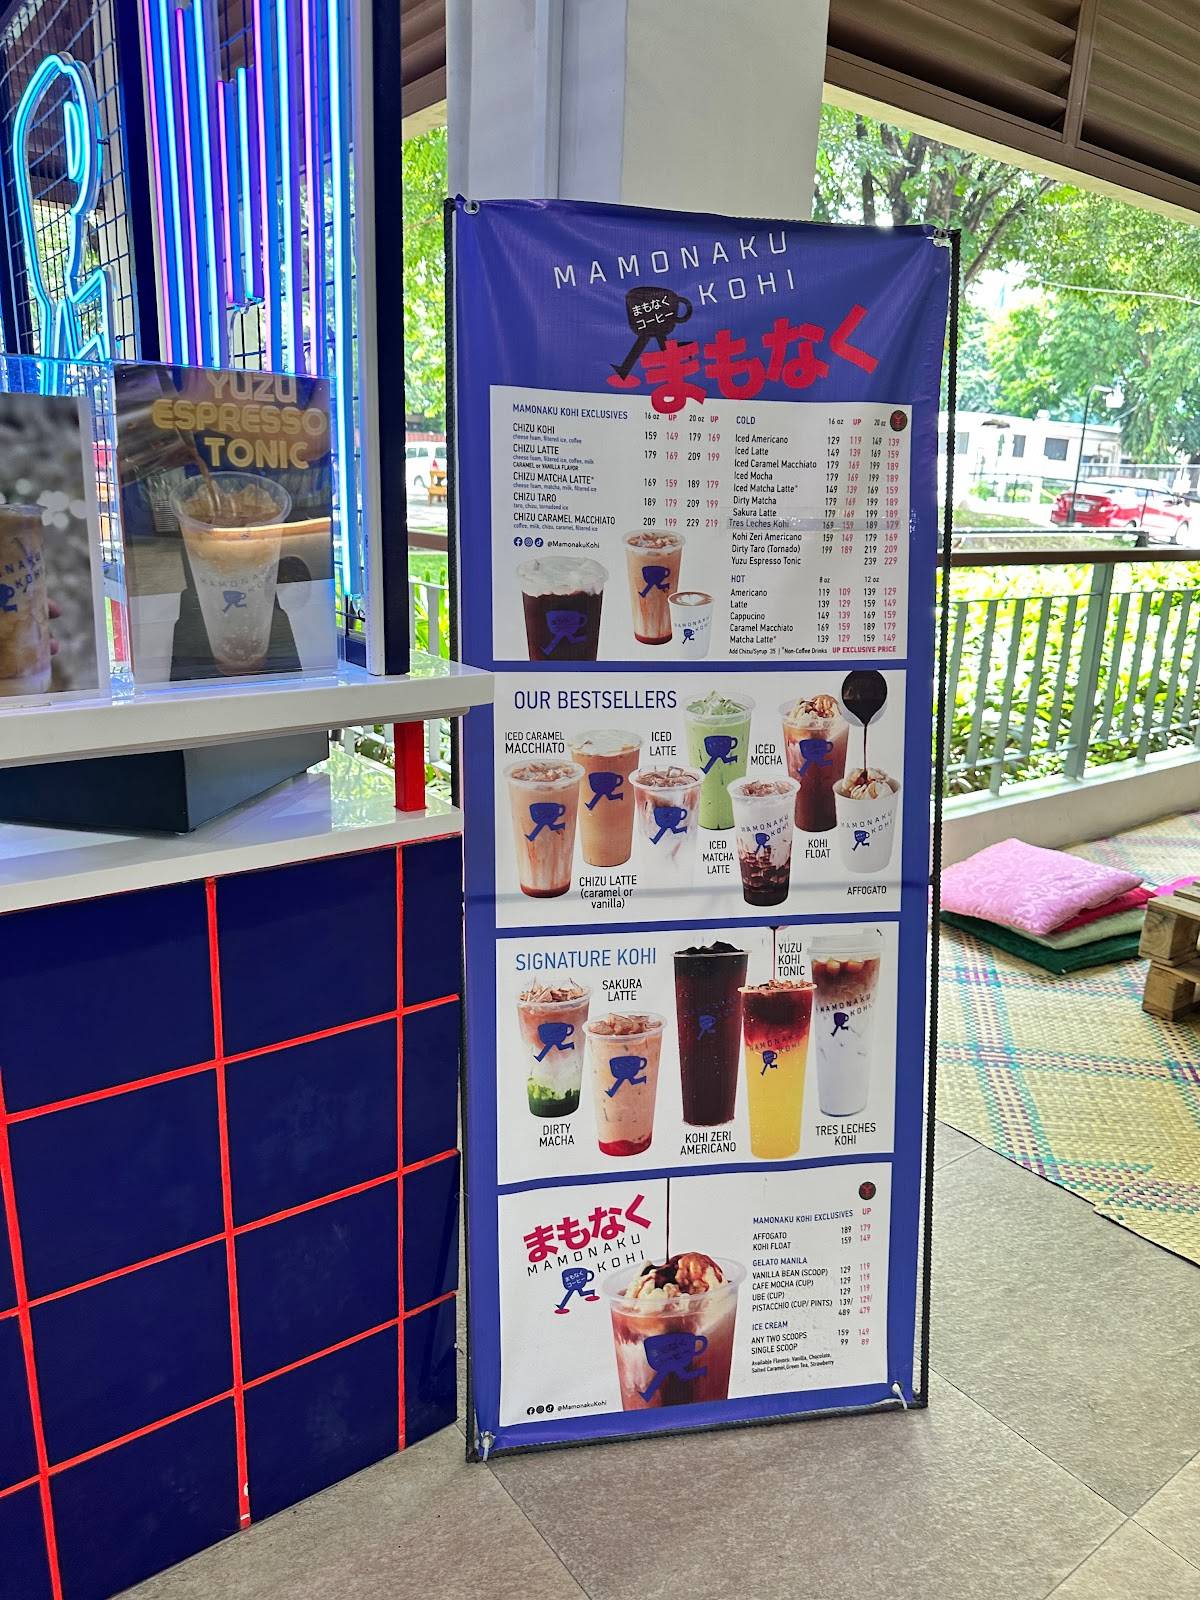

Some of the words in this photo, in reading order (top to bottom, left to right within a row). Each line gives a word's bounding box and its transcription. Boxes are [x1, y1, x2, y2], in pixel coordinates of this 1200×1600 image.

[554, 230, 788, 289] MAMONAKU
[699, 269, 794, 306] KOHI
[632, 296, 670, 316] まもなく
[635, 312, 674, 330] コーヒー
[639, 303, 878, 415] まもなく
[205, 371, 297, 403] YUZU
[513, 404, 558, 416] MAMONAKU
[560, 408, 579, 417] KOHI
[581, 409, 628, 419] EXCLUSIVES
[151, 400, 327, 435] ESPRESSO
[736, 416, 755, 424] COLD
[513, 423, 535, 433] CHIZU
[537, 425, 554, 434] KOHI
[644, 432, 657, 440] 159
[689, 433, 701, 441] 179
[708, 434, 720, 442] 169
[735, 434, 750, 443] Iced
[752, 435, 788, 444] Americano
[828, 437, 840, 445] 129
[205, 438, 309, 469] TONIC
[513, 444, 535, 453] CHIZU
[537, 445, 559, 455] LATTE
[644, 451, 656, 459] 179
[688, 452, 700, 460] 209
[735, 447, 749, 455] Iced
[827, 449, 839, 457] 149
[750, 460, 779, 468] Caramel
[781, 460, 816, 468] Macchiato
[827, 461, 839, 469] 179
[513, 472, 535, 481] CHIZU
[538, 473, 567, 483] MATCHA
[644, 479, 656, 487] 169
[688, 480, 700, 488] 189
[750, 472, 772, 480] Mocha
[826, 473, 838, 481] 179
[734, 484, 747, 492] Iced
[750, 485, 774, 493] Matcha
[513, 492, 535, 502] CHIZU
[538, 493, 556, 502] TARO
[644, 498, 656, 506] 189
[687, 500, 700, 508] 209
[734, 496, 749, 506] Dirty
[733, 509, 757, 517] Sakura
[759, 509, 776, 517] Latte
[514, 513, 535, 522] CHIZU
[538, 514, 572, 524] CARAMEL
[575, 516, 615, 525] MACCHIATO
[643, 517, 656, 525] 209
[687, 519, 699, 527] 229
[706, 519, 718, 527] 219
[732, 533, 747, 541] Kohi
[750, 533, 763, 541] Zeri
[732, 545, 747, 554] Dirty
[767, 545, 800, 554] (Tornado)
[732, 557, 747, 565] Yuzu
[750, 557, 781, 566] Espresso
[784, 557, 801, 565] Tonic
[864, 558, 876, 566] 239
[730, 600, 747, 608] Latte
[818, 600, 829, 608] 139
[730, 612, 765, 621] Cappucino
[864, 611, 875, 619] 169
[730, 624, 758, 632] Caramel
[760, 624, 793, 632] Macchiato
[863, 634, 875, 642] 159
[514, 691, 551, 709] OUR
[558, 690, 677, 709] BESTSELLERS
[505, 732, 524, 741] ICED
[526, 732, 564, 740] CARAMEL
[651, 732, 672, 742] ICED
[505, 743, 565, 754] MACCHIATO
[650, 746, 676, 756] LATTE
[756, 744, 776, 754] ICED
[751, 756, 782, 765] MOCHA
[709, 841, 726, 850] ICED
[808, 840, 828, 848] KOHI
[702, 853, 734, 861] MATCHA
[806, 849, 831, 859] FLOAT
[707, 865, 730, 874] LATTE
[579, 877, 607, 887] CHIZU
[610, 875, 637, 886] LATTE
[580, 888, 621, 898] (caramel
[624, 888, 633, 897] or
[847, 886, 886, 895] AFFOGATO
[591, 899, 625, 909] vanilla)
[778, 943, 802, 953] YUZU
[516, 950, 611, 970] SIGNATURE
[618, 948, 656, 965] KOHI
[778, 955, 800, 964] KOHI
[778, 966, 805, 976] TONIC
[602, 979, 642, 990] SAKURA
[608, 990, 636, 1002] LATTE
[543, 1123, 571, 1136] DIRTY
[816, 1124, 838, 1136] TRES
[841, 1122, 876, 1134] LECHES
[539, 1135, 574, 1147] MACHA
[685, 1134, 708, 1143] KOHI
[711, 1131, 731, 1141] ZERI
[835, 1135, 856, 1146] KOHI
[680, 1142, 736, 1155] AMERICANO
[753, 1216, 794, 1224] MAMONAKU
[796, 1214, 812, 1223] KOHI
[814, 1210, 853, 1222] EXCLUSIVES
[523, 1194, 651, 1262] まもなく
[753, 1232, 787, 1240] AFFOGATO
[753, 1243, 768, 1251] KOHI
[771, 1242, 791, 1250] FLOAT
[527, 1233, 641, 1276] MAMONAKU
[597, 1250, 645, 1273] KOHI
[753, 1258, 778, 1266] GELATO
[780, 1257, 807, 1265] MANILA
[752, 1271, 780, 1279] VANILLA
[771, 1281, 794, 1289] MOCHA
[768, 1292, 784, 1300] (CUP)
[752, 1302, 789, 1312] PISTACCHIO
[765, 1321, 788, 1329] CREAM
[752, 1335, 765, 1344] ANY
[767, 1334, 780, 1342] TWO
[782, 1332, 807, 1341] SCOOPS
[752, 1346, 774, 1354] SINGLE
[777, 1343, 797, 1352] SCOOP
